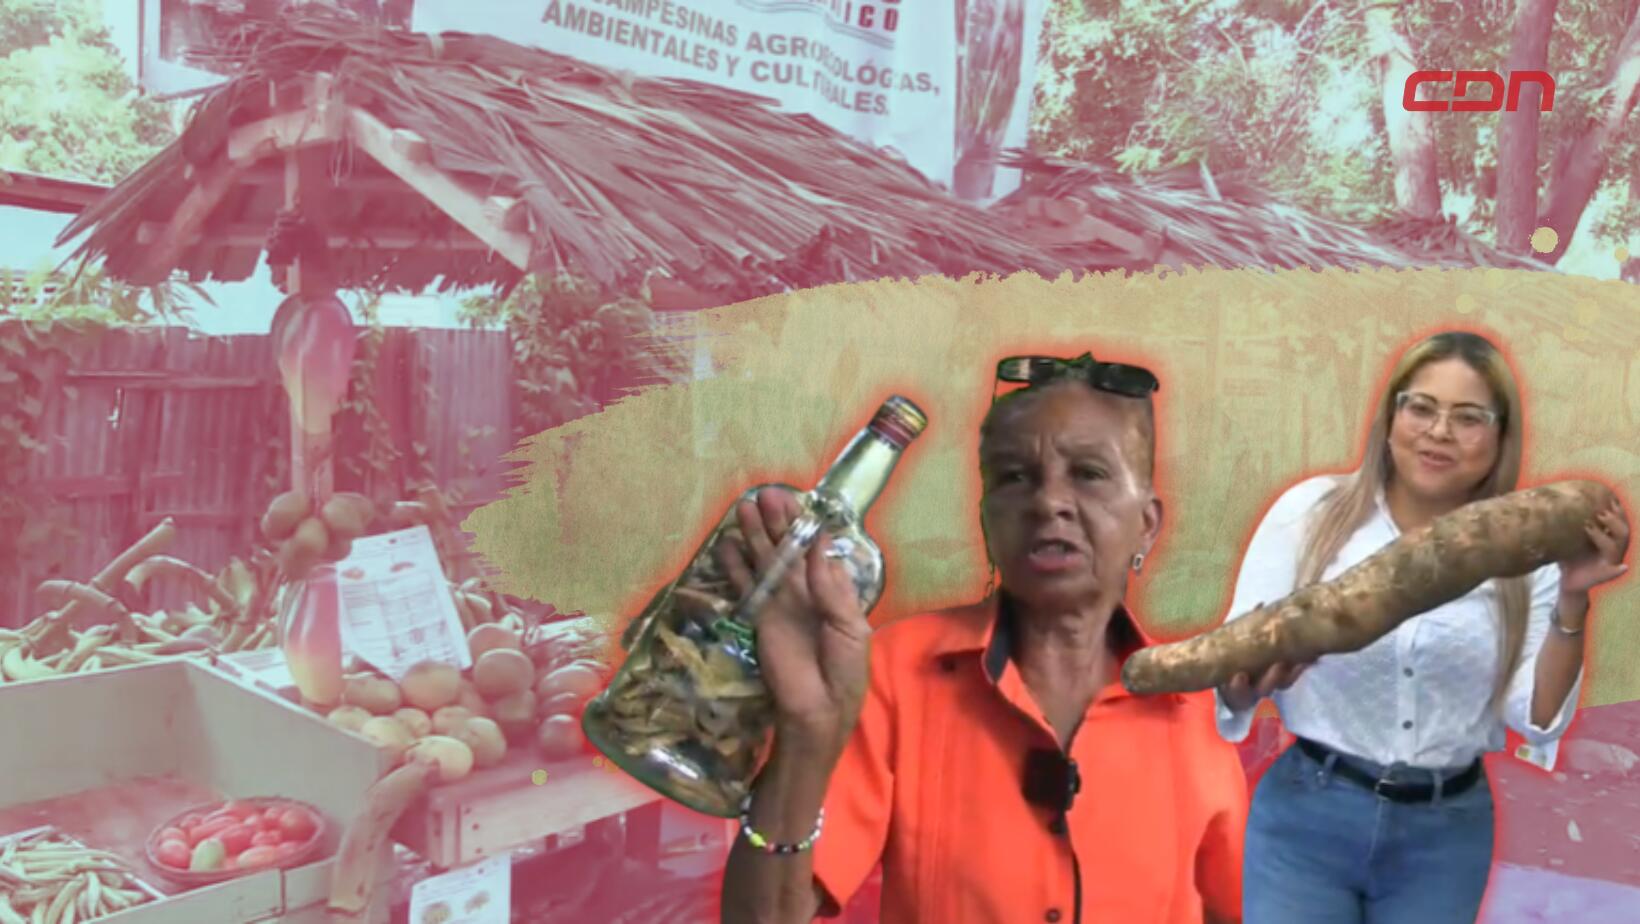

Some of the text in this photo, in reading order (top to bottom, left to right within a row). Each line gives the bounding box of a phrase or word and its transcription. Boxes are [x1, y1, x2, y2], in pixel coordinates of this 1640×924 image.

[541, 0, 889, 115] AMBIENTALES Y CULTALES.
[592, 0, 738, 47] MPESINAS
